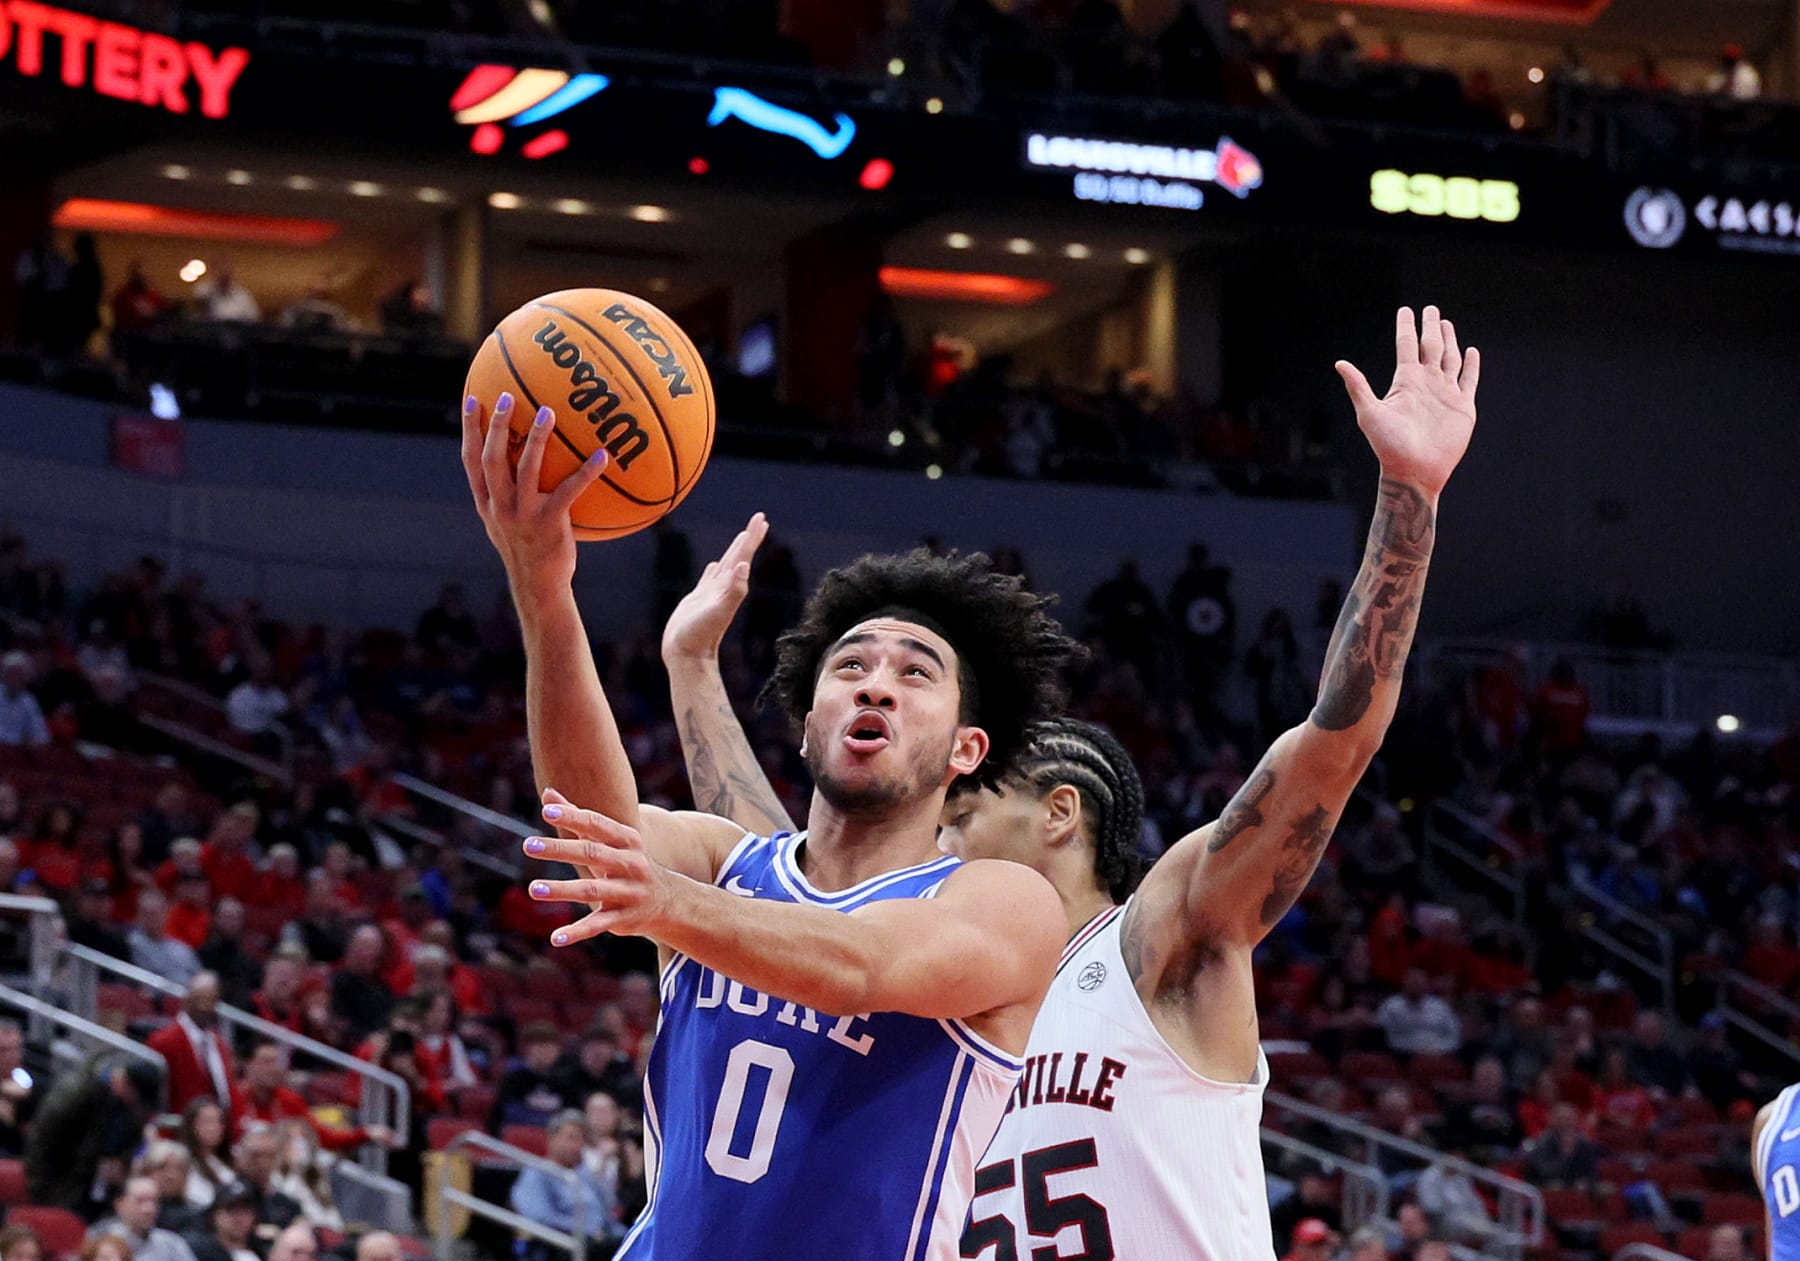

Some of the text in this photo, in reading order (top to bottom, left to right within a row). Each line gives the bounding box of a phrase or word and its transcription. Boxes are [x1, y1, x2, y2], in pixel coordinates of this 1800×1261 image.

[0, 0, 251, 120] TTERY
[533, 321, 650, 472] Wilson
[601, 303, 693, 399] NCAA
[704, 1038, 796, 1184] 0
